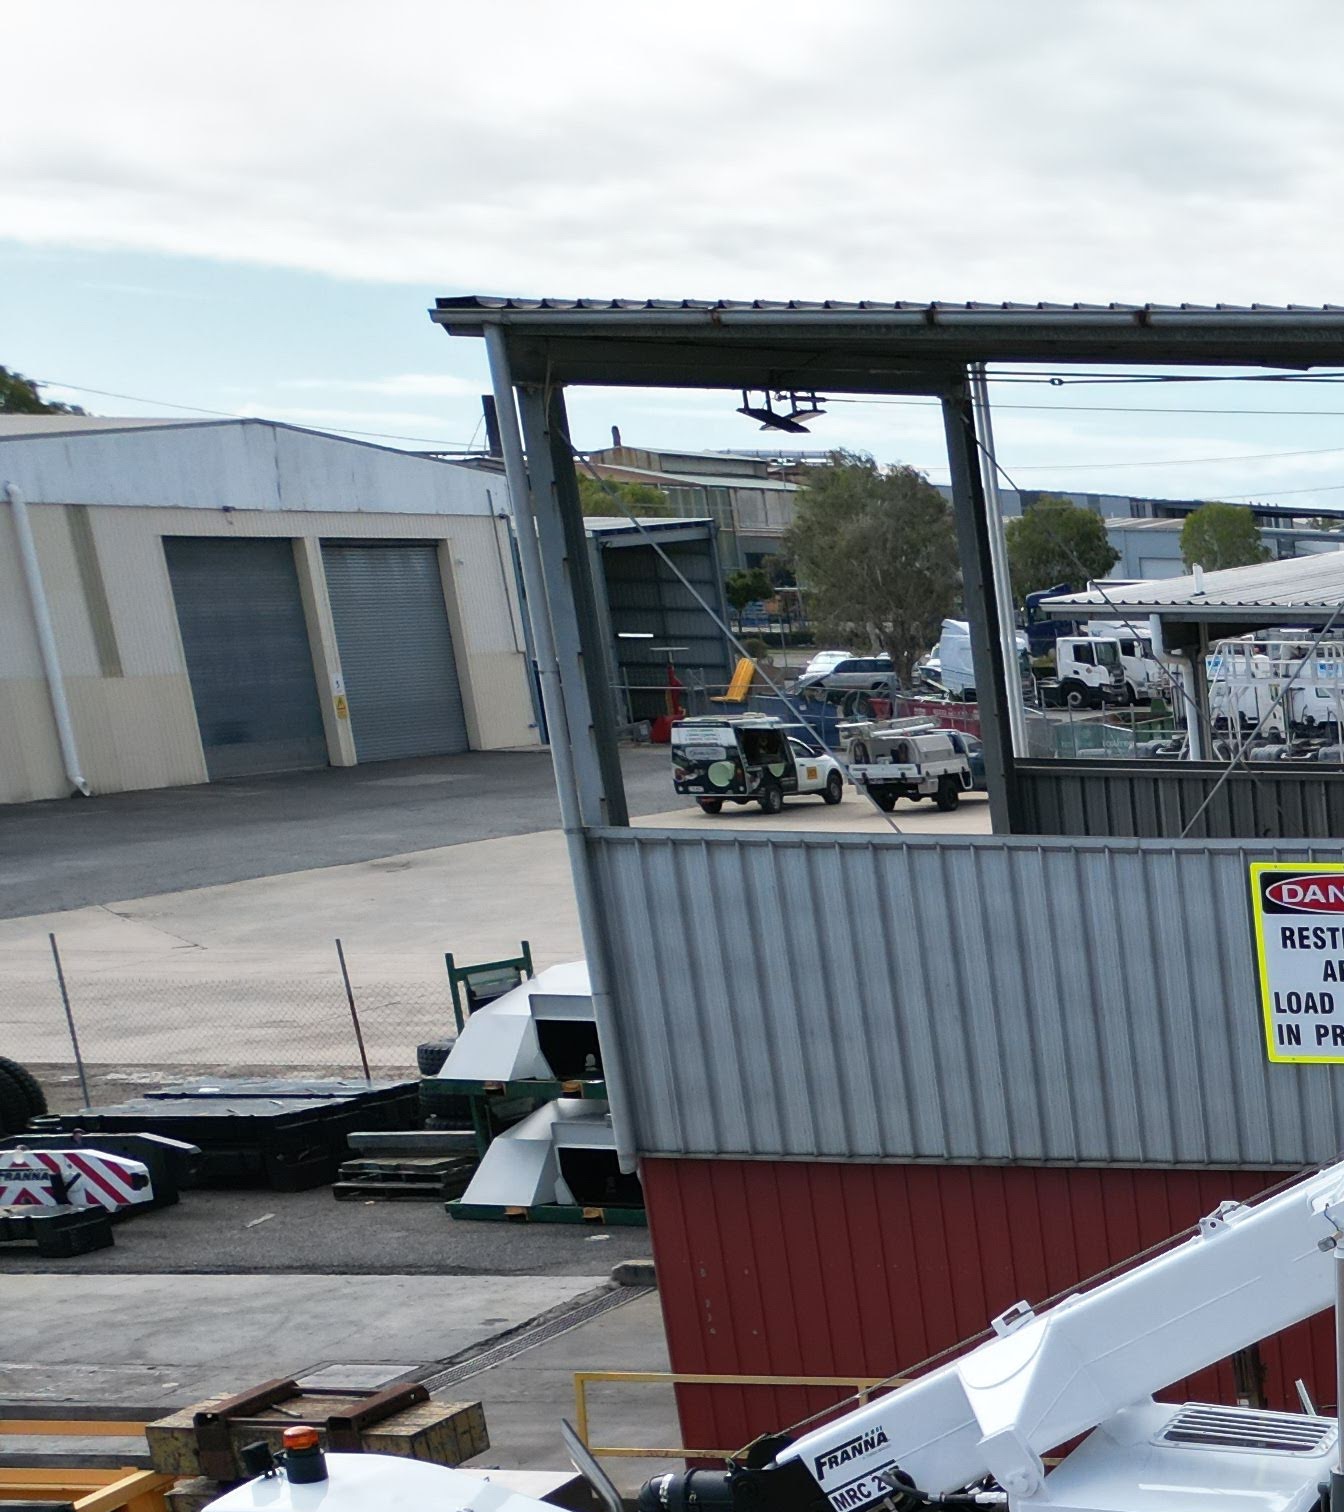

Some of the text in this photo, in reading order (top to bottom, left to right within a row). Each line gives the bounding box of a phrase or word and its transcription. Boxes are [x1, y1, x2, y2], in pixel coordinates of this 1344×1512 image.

[1273, 991, 1335, 1015] LOAD
[1277, 1023, 1302, 1046] IN
[814, 1431, 889, 1482] FRANNA
[832, 1482, 872, 1512] MRC
